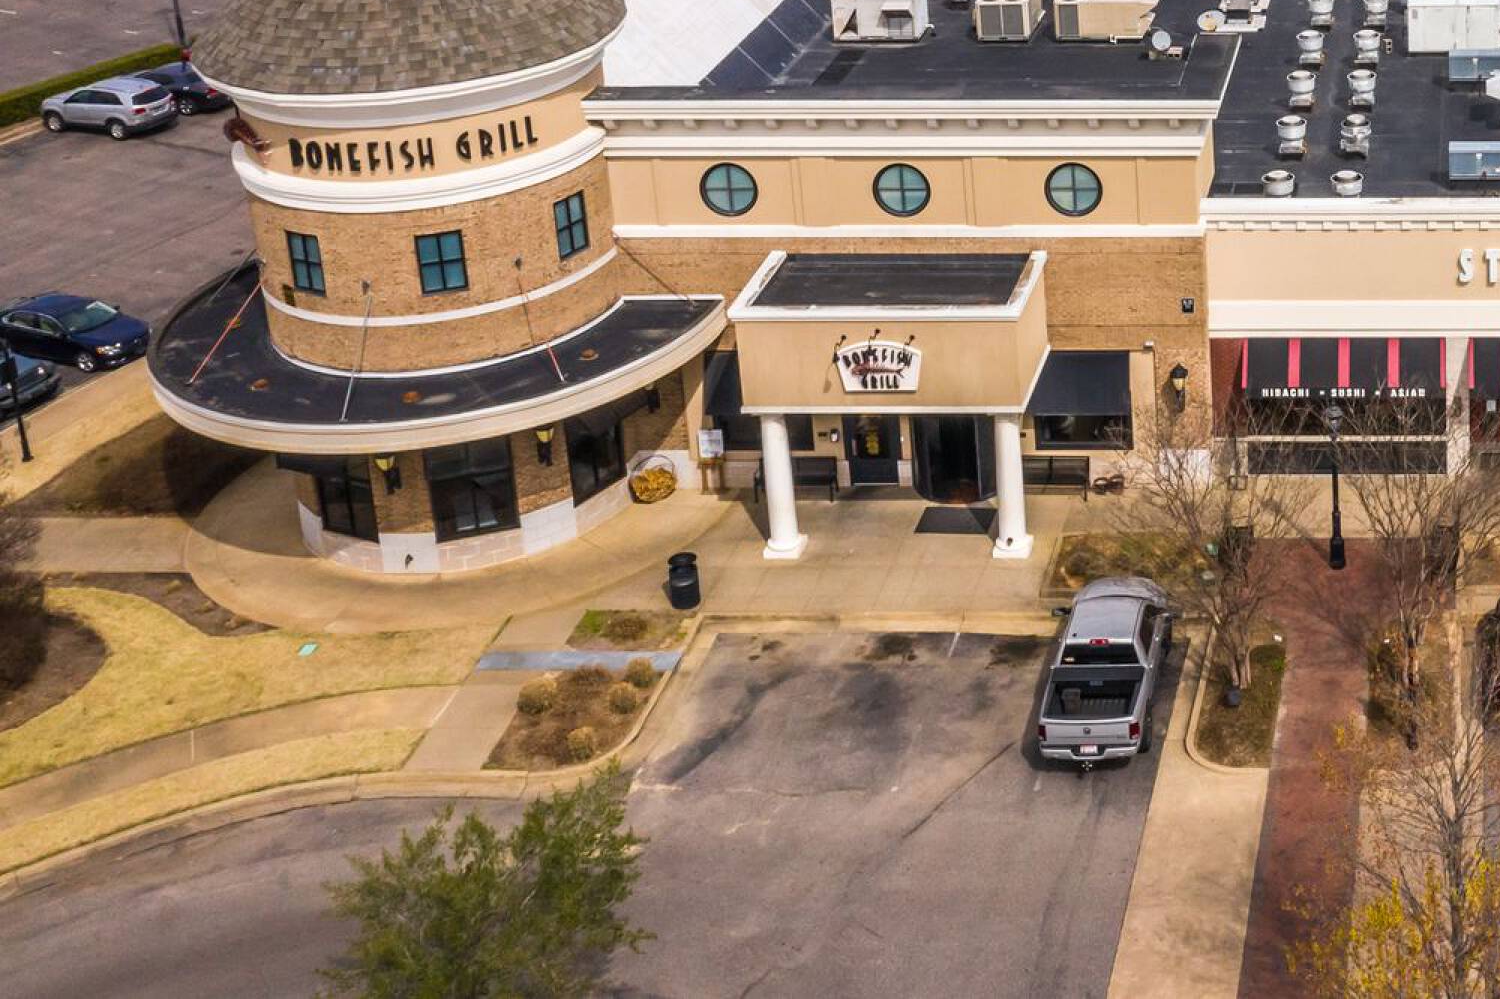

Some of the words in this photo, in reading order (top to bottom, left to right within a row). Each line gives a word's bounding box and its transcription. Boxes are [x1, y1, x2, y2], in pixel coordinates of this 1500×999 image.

[288, 137, 435, 172] BONEFISH
[455, 115, 538, 160] GRILL
[861, 374, 899, 389] GRILL
[1262, 388, 1310, 398] HIBACHI
[1330, 388, 1366, 398] SUSHI
[1390, 388, 1426, 398] ASIAN
